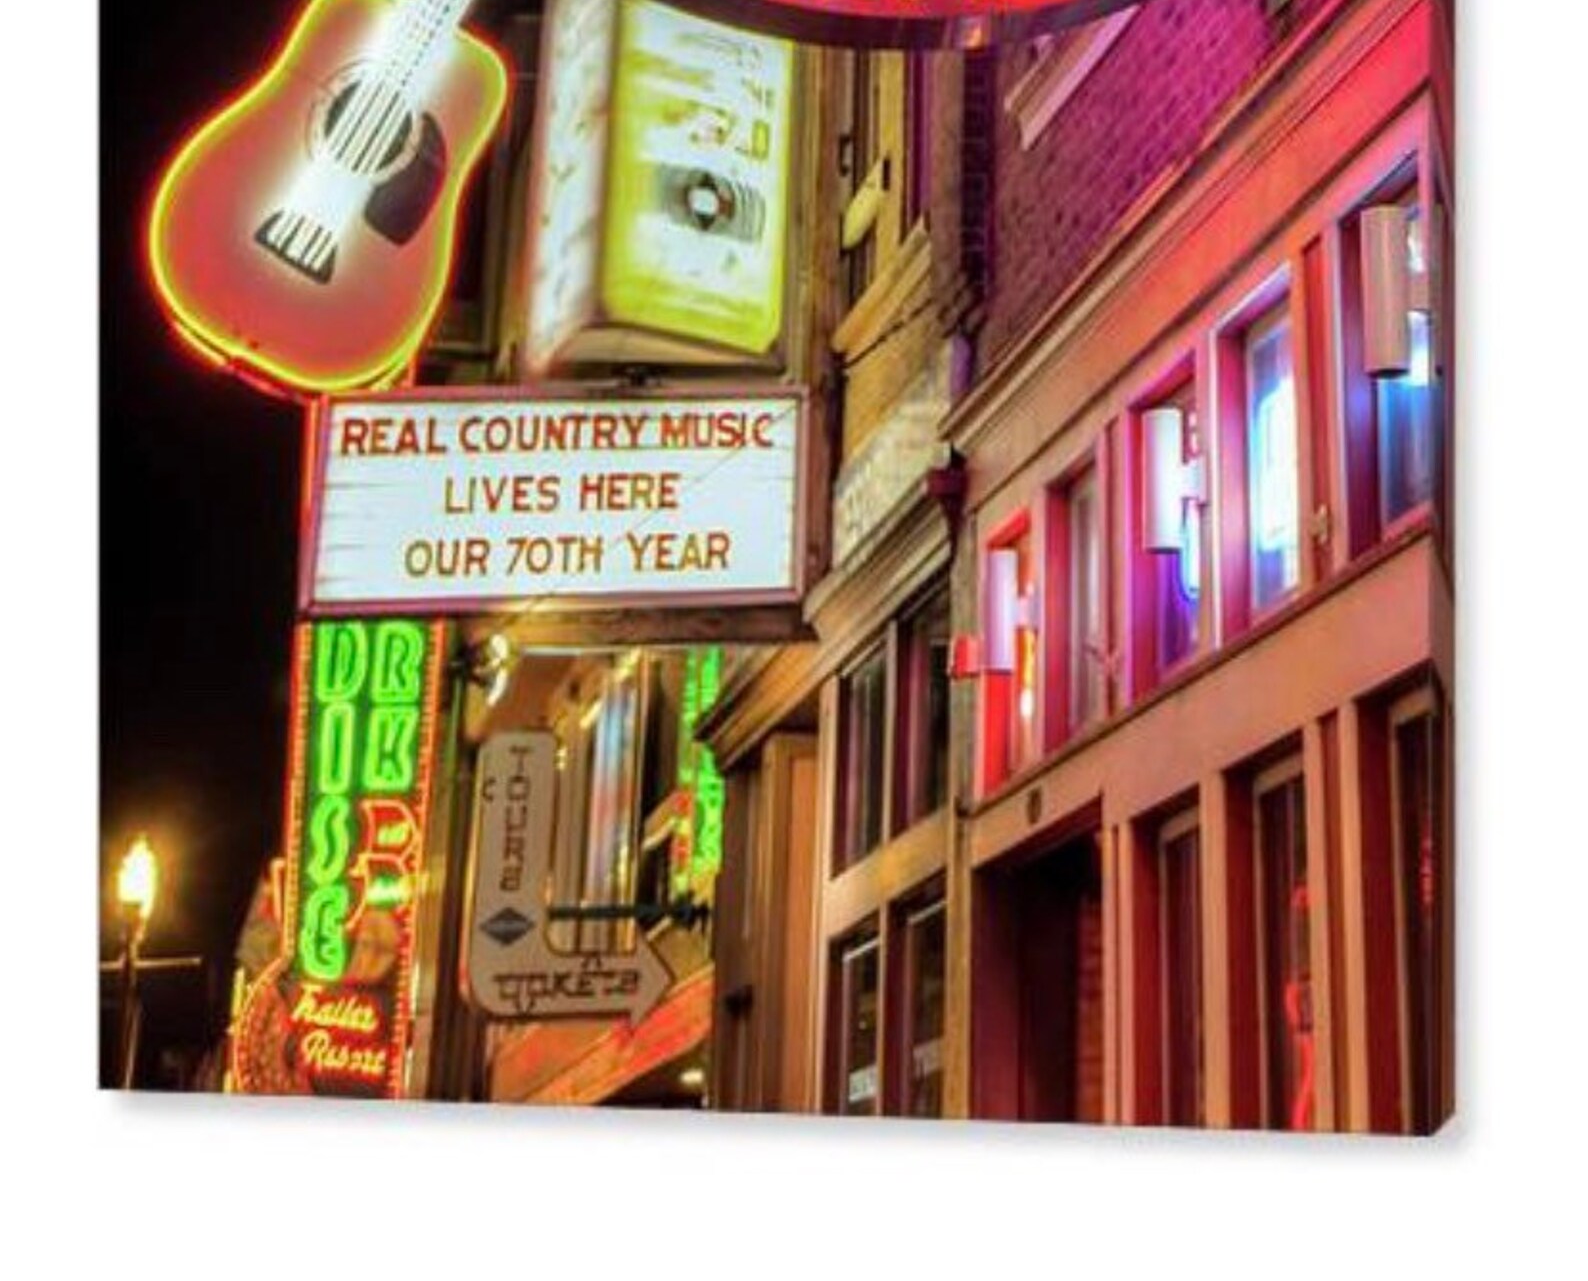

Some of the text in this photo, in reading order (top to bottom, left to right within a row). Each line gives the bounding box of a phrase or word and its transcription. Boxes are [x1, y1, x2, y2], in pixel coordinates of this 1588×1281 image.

[340, 412, 773, 457] REAL COUNTRY MUSIC
[445, 472, 681, 515] LIVES HERE
[404, 532, 730, 578] OUR 70TH YEAR
